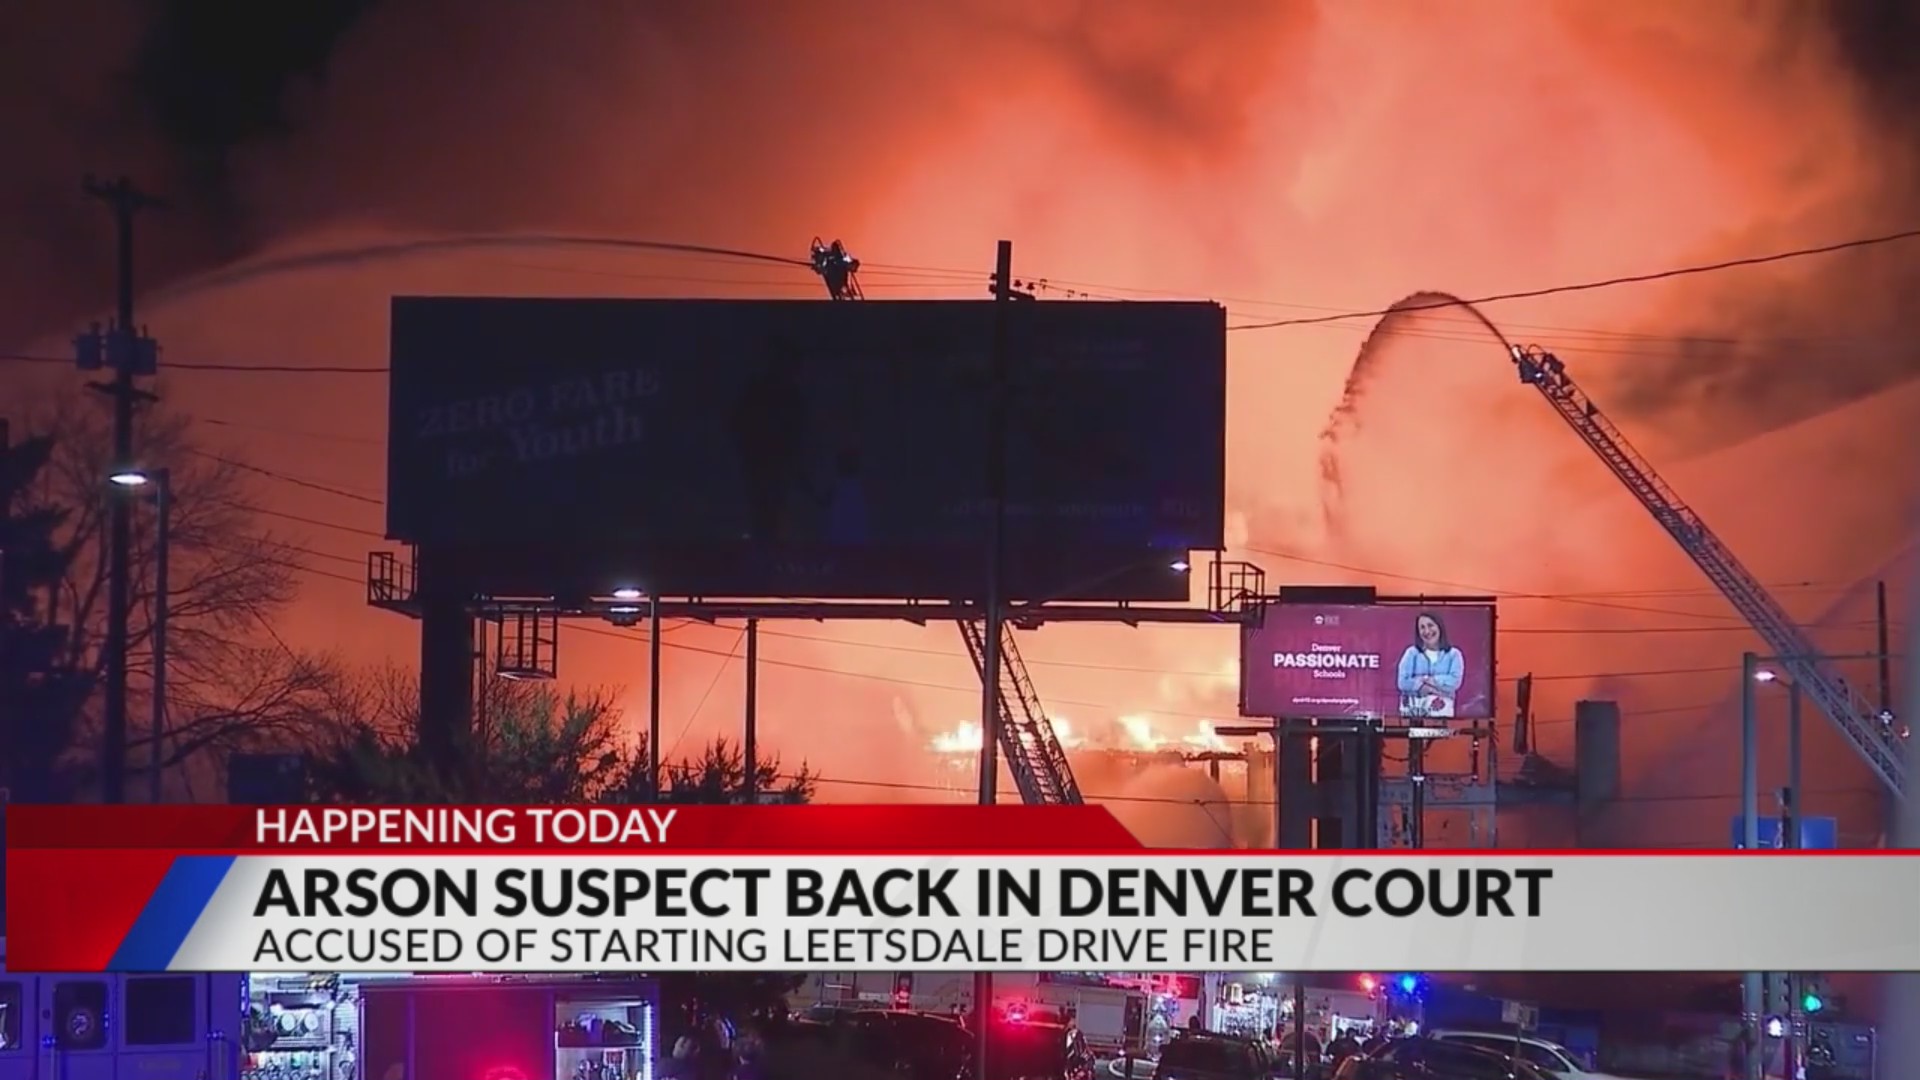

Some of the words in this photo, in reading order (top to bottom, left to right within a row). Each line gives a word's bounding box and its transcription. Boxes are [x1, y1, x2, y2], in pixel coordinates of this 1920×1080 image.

[416, 386, 533, 438] ZERO
[551, 366, 663, 411] FARE
[505, 403, 642, 463] Youth
[1312, 643, 1341, 652] Denver
[1274, 653, 1379, 669] PASSIONATE
[1314, 669, 1345, 679] Schools
